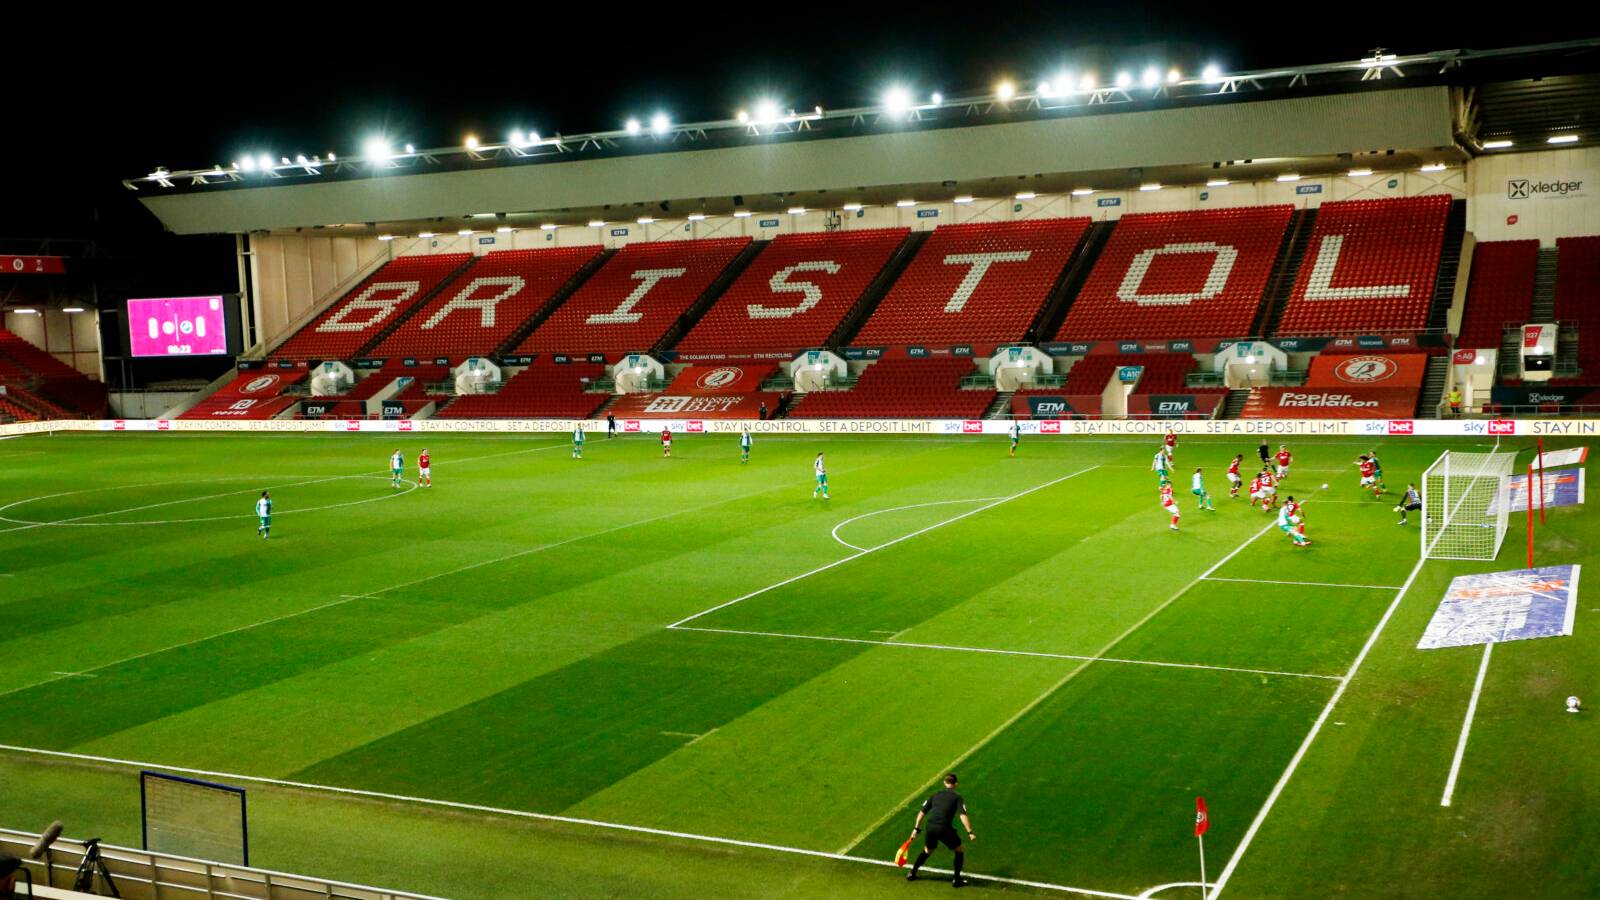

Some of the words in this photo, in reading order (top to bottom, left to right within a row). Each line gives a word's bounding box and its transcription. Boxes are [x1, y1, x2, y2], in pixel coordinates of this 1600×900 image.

[1530, 180, 1583, 194] xledger
[315, 234, 1411, 333] BRISTOL
[1280, 392, 1352, 400] Poplar
[307, 406, 325, 414] ETM
[384, 406, 403, 415] ETM
[682, 401, 734, 412] BET
[1038, 402, 1066, 410] ETM
[1158, 402, 1189, 410] ETM
[421, 422, 440, 430] STAY
[442, 422, 451, 430] IN
[507, 422, 522, 430] SET
[533, 422, 572, 430] DEPOSIT
[626, 421, 640, 430] bet
[672, 422, 684, 431] sky
[688, 421, 702, 430] bet
[714, 422, 738, 432] STAY
[740, 422, 751, 432] IN
[819, 422, 838, 432] SET
[840, 422, 848, 432] A
[850, 422, 898, 432] DEPOSIT
[902, 422, 932, 432] LIMIT
[944, 422, 960, 432] sky
[964, 421, 982, 431] bet
[1022, 422, 1038, 432] sky
[1040, 422, 1059, 431] bet
[1074, 422, 1104, 432] STAY
[1108, 422, 1121, 432] IN
[1206, 422, 1228, 432] SET
[1232, 422, 1242, 432] A
[1246, 422, 1306, 433] DEPOSIT
[1310, 422, 1348, 433] LIMIT
[1366, 422, 1386, 432] sky
[1389, 421, 1412, 432] bet
[1464, 422, 1485, 433] sky
[1490, 421, 1513, 432] bet
[1533, 422, 1572, 434] STAY
[1578, 422, 1595, 434] IN
